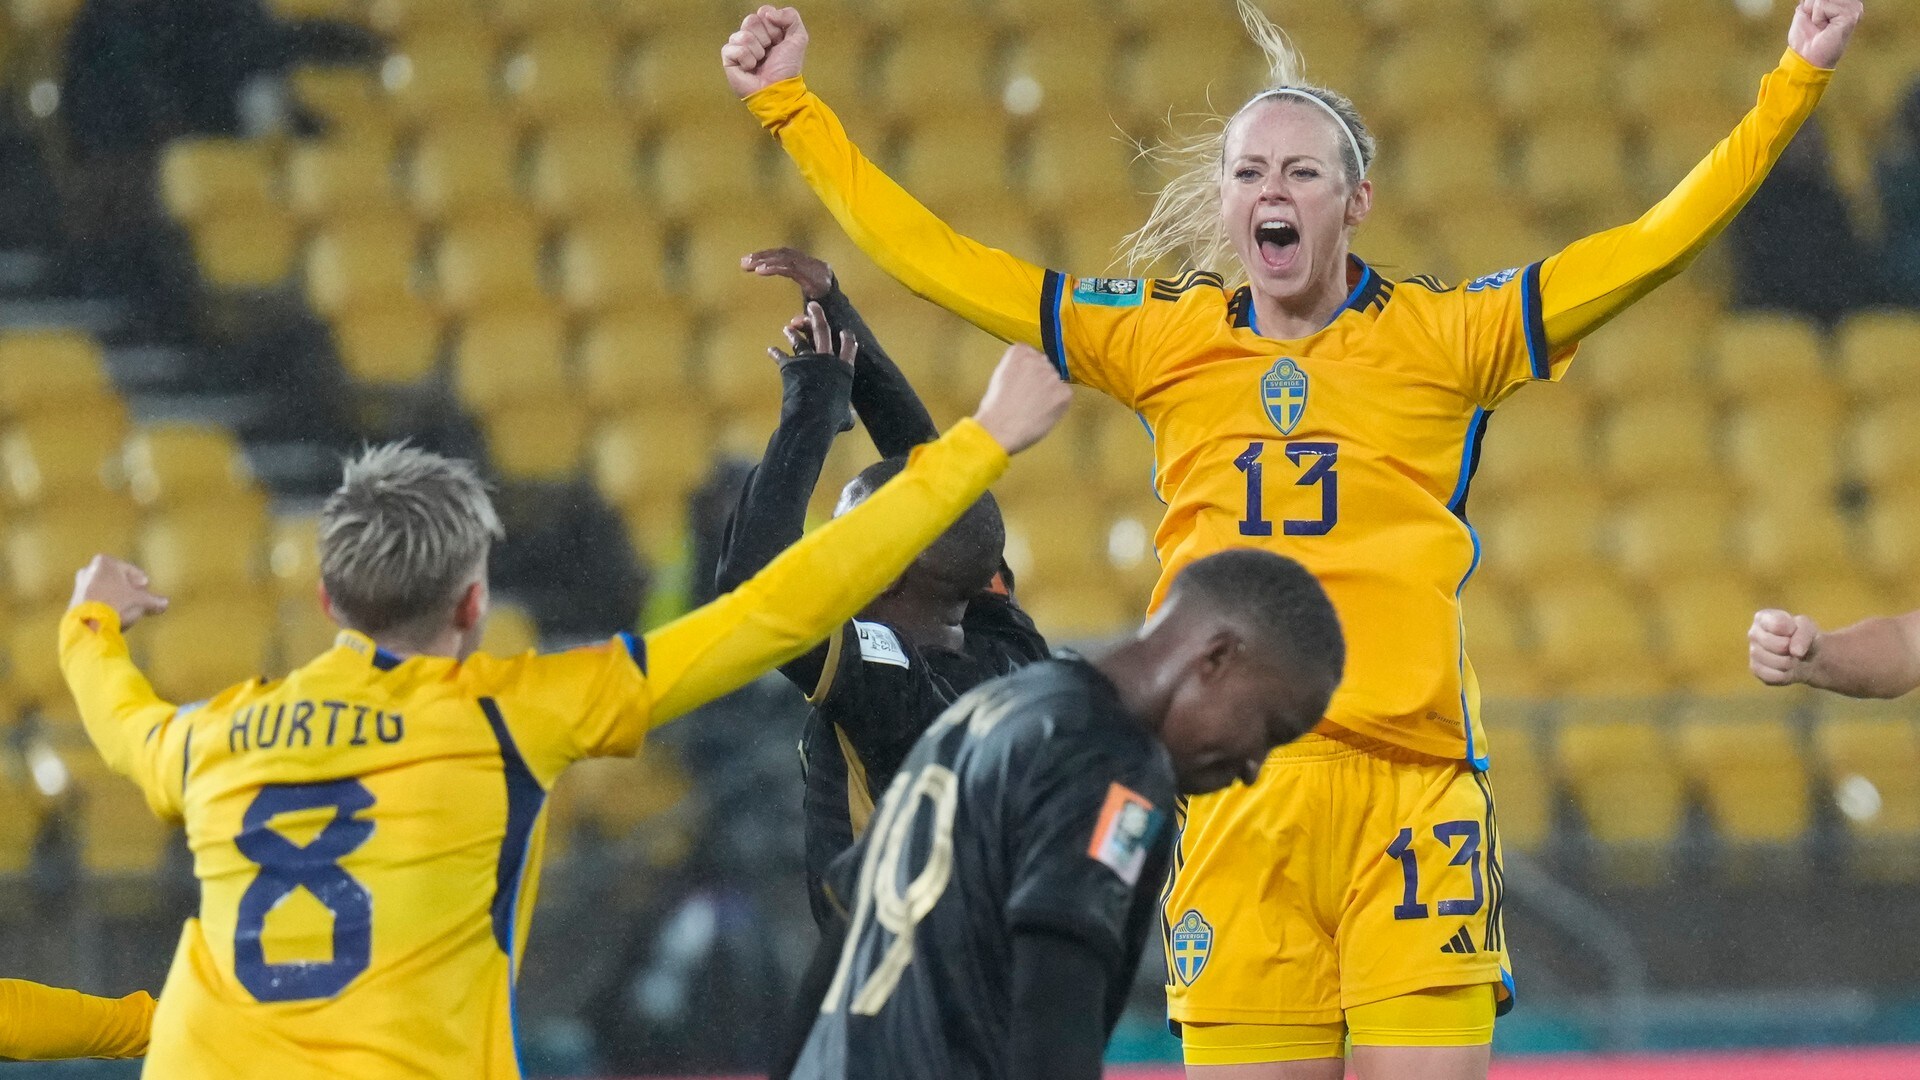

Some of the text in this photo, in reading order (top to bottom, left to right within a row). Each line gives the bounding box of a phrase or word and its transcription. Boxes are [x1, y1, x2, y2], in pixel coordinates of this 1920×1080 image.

[1234, 442, 1339, 536] 13
[229, 700, 404, 752] HURTIG
[234, 777, 377, 1004] 8
[820, 763, 958, 1016] 19
[1386, 820, 1485, 920] 13
